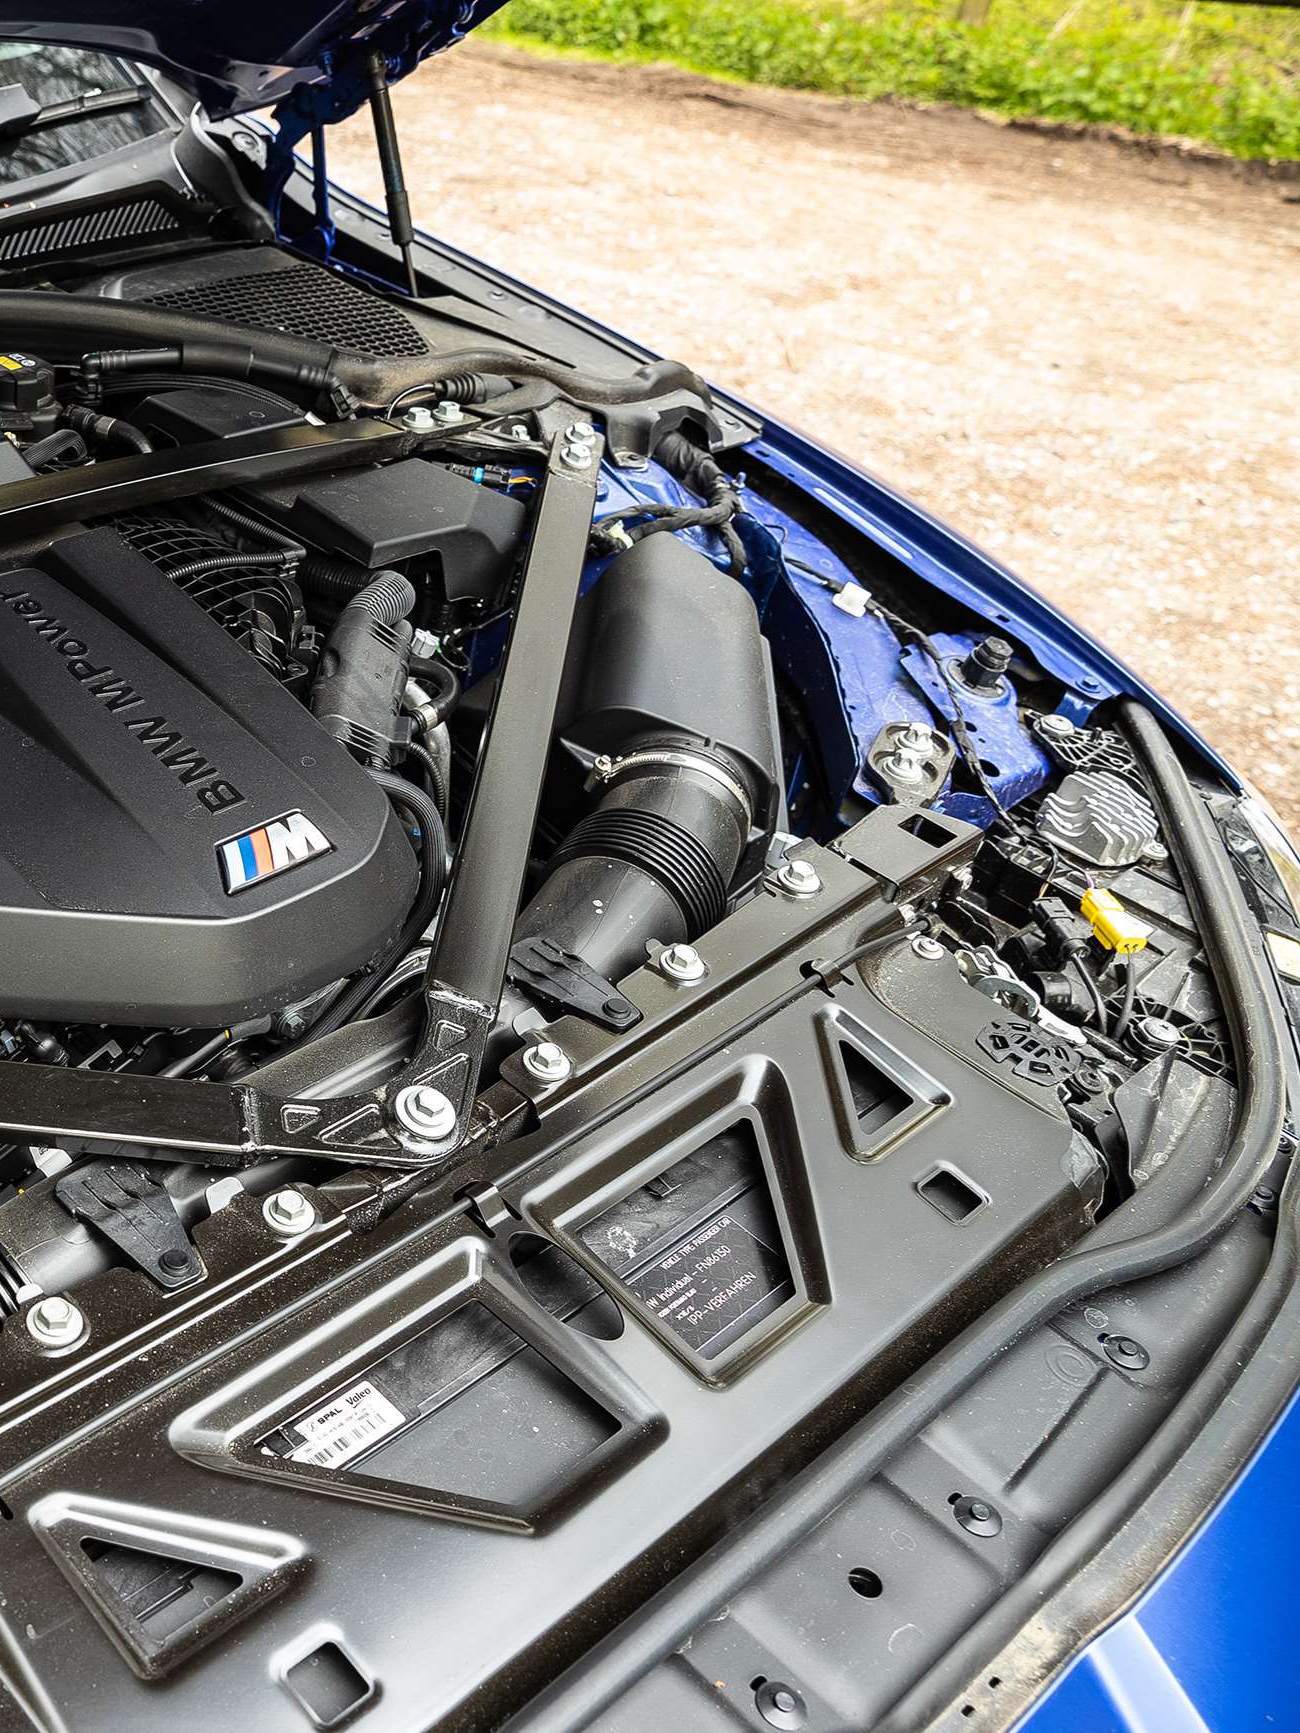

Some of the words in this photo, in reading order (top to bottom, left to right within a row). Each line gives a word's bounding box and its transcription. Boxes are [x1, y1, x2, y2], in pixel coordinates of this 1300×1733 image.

[123, 716, 248, 816] BMW
[656, 1273, 694, 1301] Individual
[694, 1245, 732, 1272] FN86150
[317, 1408, 343, 1424] SPAL
[345, 1388, 371, 1405] Valeo
